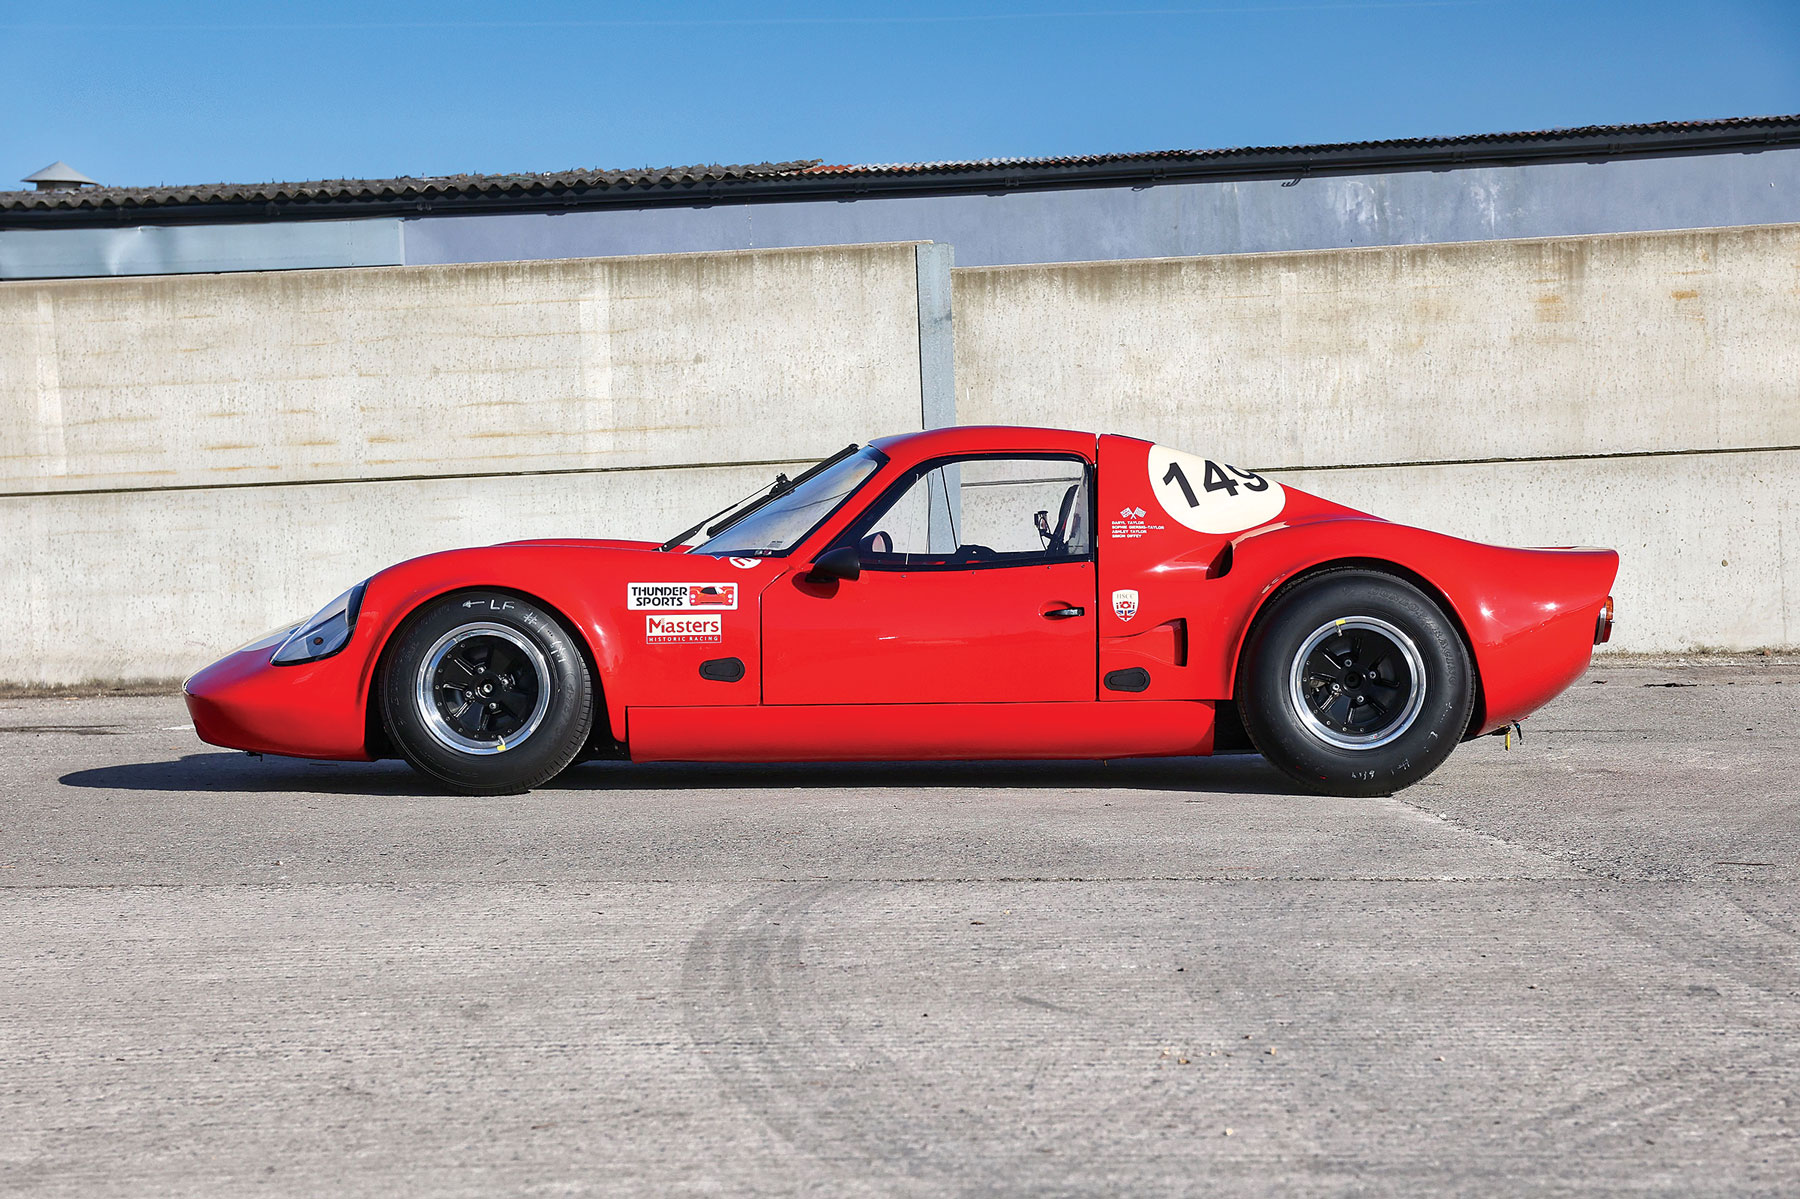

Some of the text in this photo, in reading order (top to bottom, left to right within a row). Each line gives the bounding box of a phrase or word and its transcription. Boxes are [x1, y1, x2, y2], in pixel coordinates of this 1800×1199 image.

[1162, 459, 1269, 508] 149
[631, 586, 688, 597] THUNDER
[490, 599, 515, 610] LF
[635, 596, 683, 607] SPORTS
[648, 616, 720, 634] Masters
[688, 634, 719, 642] RACING
